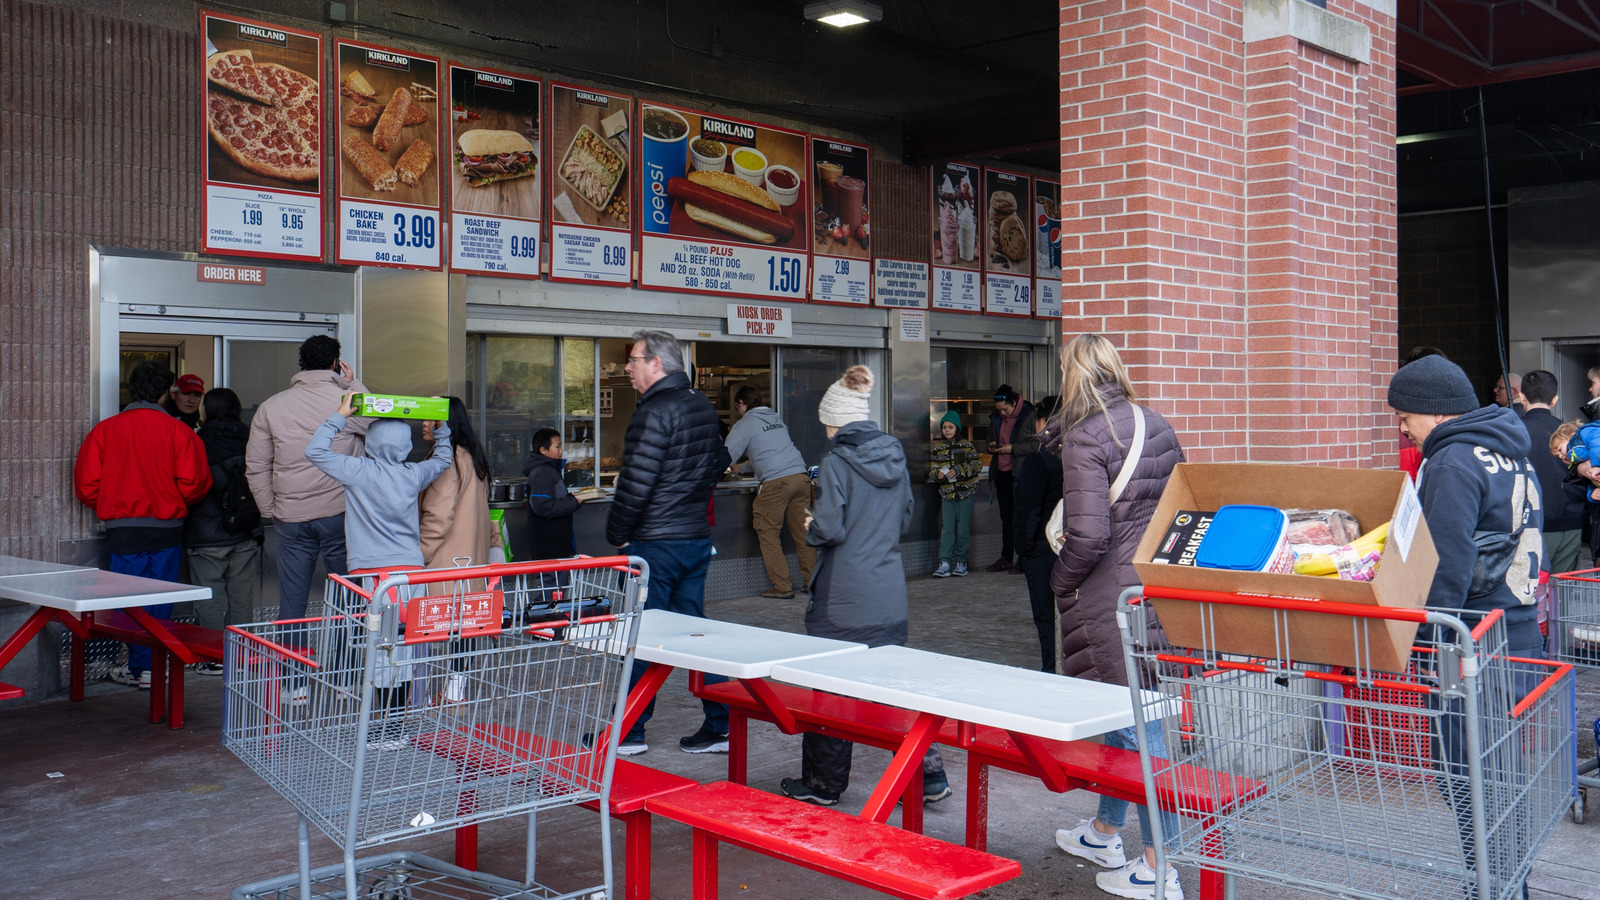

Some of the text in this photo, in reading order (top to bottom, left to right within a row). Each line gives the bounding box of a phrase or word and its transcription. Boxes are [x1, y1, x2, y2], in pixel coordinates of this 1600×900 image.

[241, 25, 286, 40] KIRKLAND
[368, 51, 408, 65] KIRKLAND
[477, 73, 512, 86] KIRKLAND
[576, 92, 608, 103] KIRKLAND
[703, 119, 754, 139] KIRKLAND
[830, 143, 852, 153] KIRKLAND
[947, 164, 966, 172] KIRKLAND
[648, 162, 669, 224] pepsi
[242, 210, 262, 225] 1.99
[282, 213, 303, 230] 9.95
[350, 209, 383, 220] CHICKEN
[356, 219, 377, 229] BAKE
[464, 218, 501, 229] ROAST BEEF
[394, 213, 435, 249] 3.99
[467, 227, 499, 237] SANDWICH
[511, 235, 535, 258] 9.99
[690, 245, 708, 254] POUND
[710, 246, 734, 256] PLUS
[376, 252, 406, 263] 840 cal.
[604, 245, 626, 266] 6.99
[674, 252, 741, 268] ALL BEEF HOT DOG
[660, 263, 676, 274] AND
[678, 265, 686, 274] 20
[701, 267, 720, 278] SODA
[723, 271, 737, 280] (With
[835, 260, 849, 275] 2.99
[890, 260, 903, 269] Calories
[204, 267, 262, 282] ORDER HERE
[768, 256, 801, 293] 1.50
[883, 270, 895, 278] general
[942, 271, 951, 281] 2.49
[964, 274, 972, 284] 1.99
[685, 277, 698, 287] 580
[705, 279, 718, 289] 850
[720, 281, 732, 290] cal.
[887, 279, 898, 287] calorie
[878, 287, 893, 295] Additional
[909, 290, 926, 298] information
[1014, 285, 1029, 303] 2.49
[737, 305, 783, 321] KIOSK ORDER
[746, 321, 775, 335] PICK-UP
[1178, 516, 1213, 565] REAKFAST
